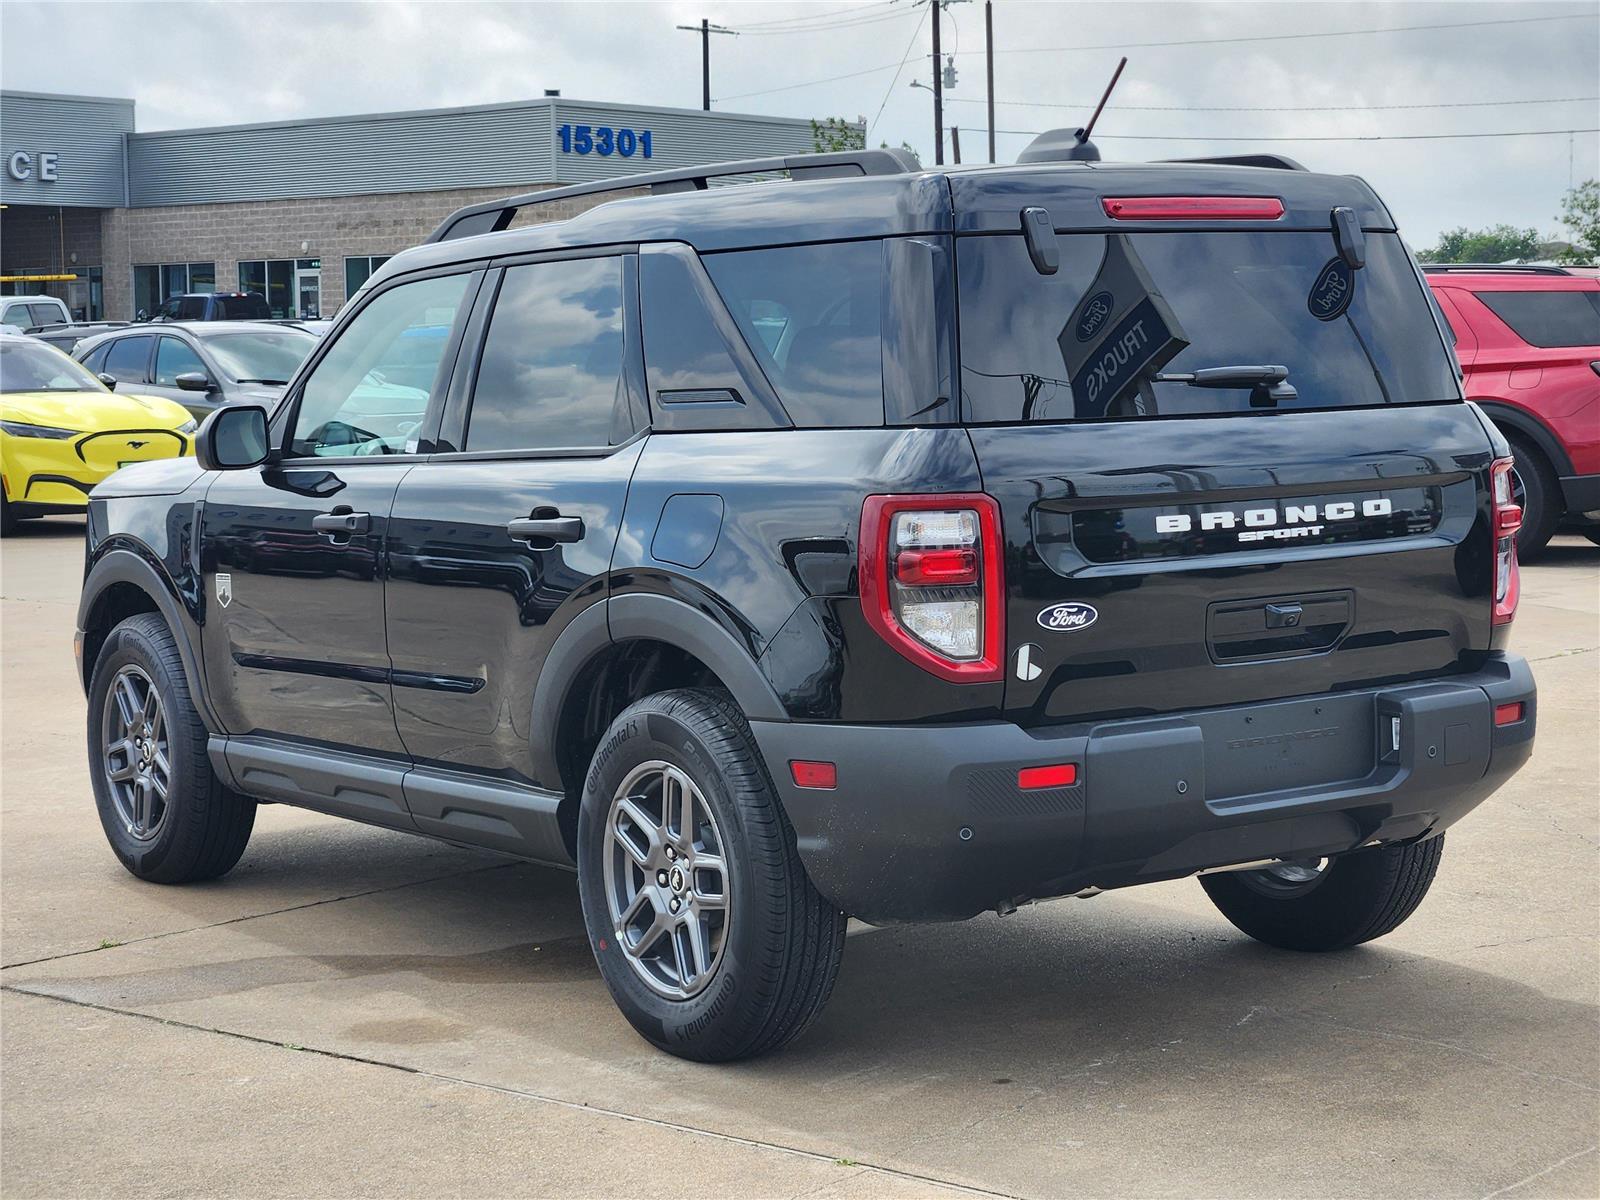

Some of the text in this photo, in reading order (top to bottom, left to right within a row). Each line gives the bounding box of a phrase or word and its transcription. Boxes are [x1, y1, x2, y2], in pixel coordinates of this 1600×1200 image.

[556, 124, 652, 159] 15301
[1155, 498, 1393, 534] BRONCO
[1237, 525, 1325, 542] SPORT
[1048, 606, 1088, 628] Ford
[586, 722, 632, 795] Continental
